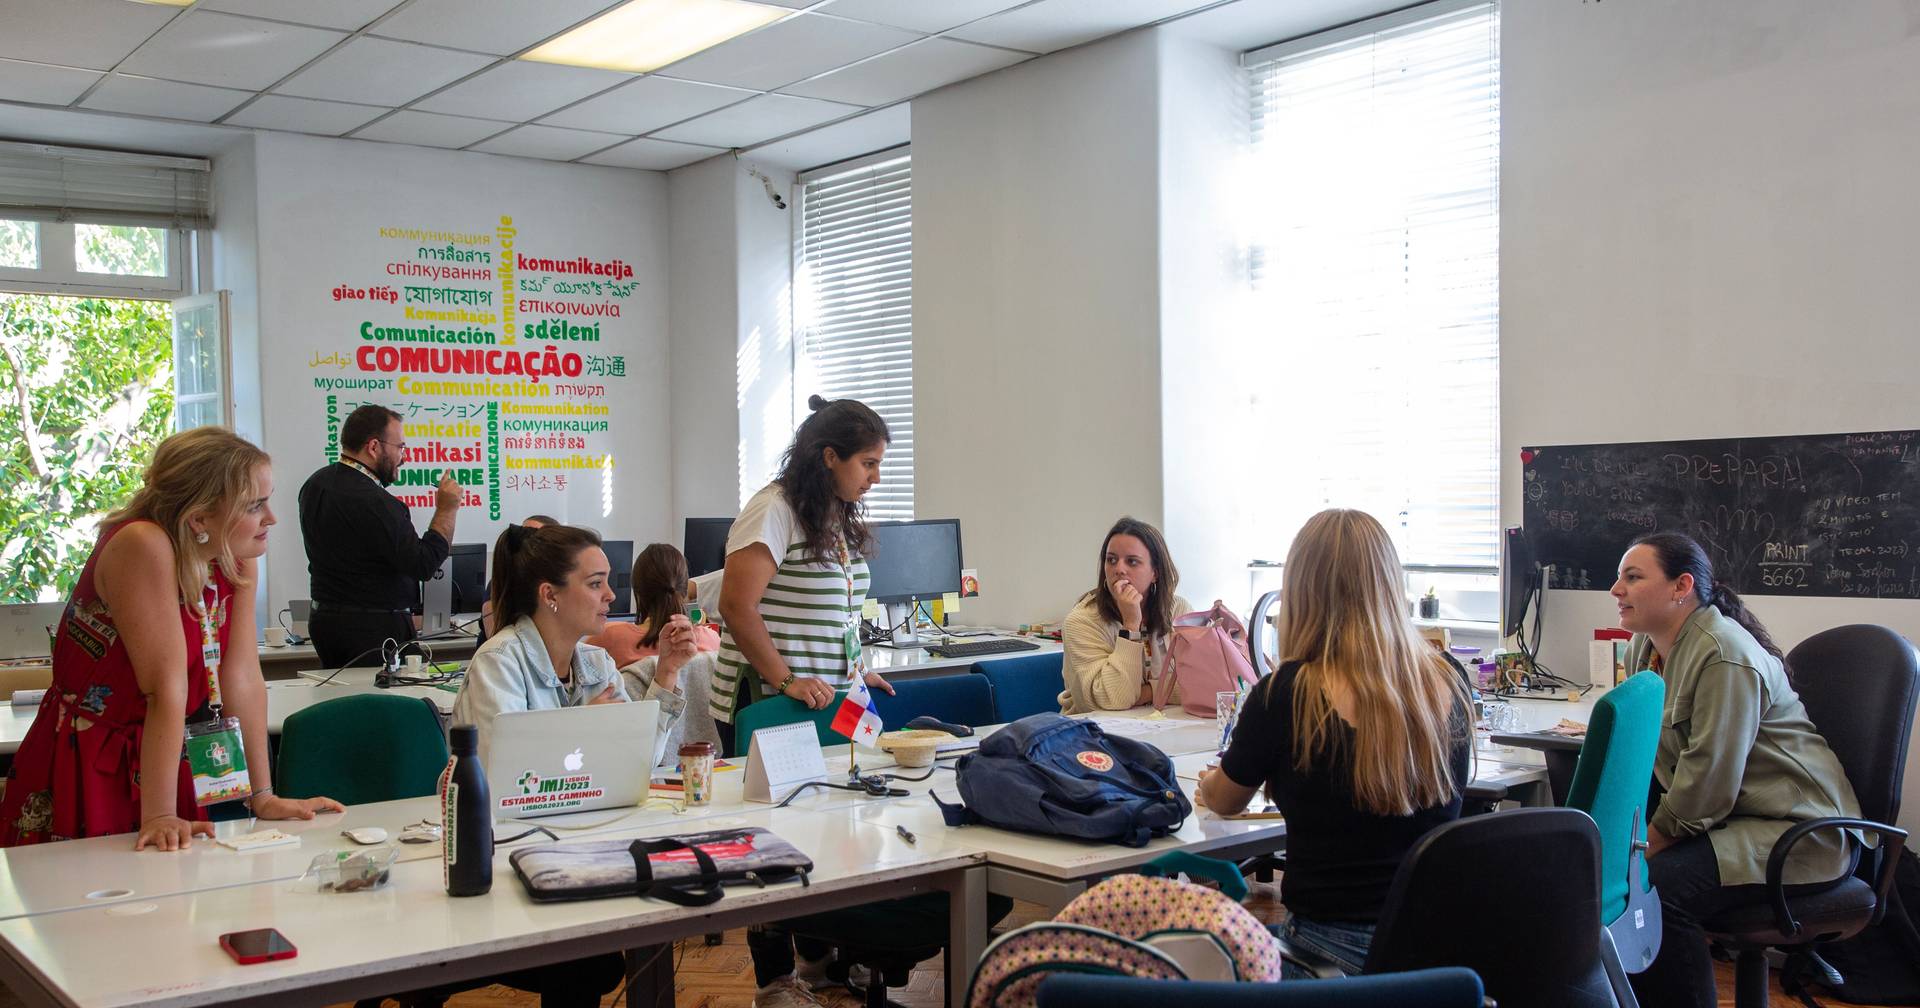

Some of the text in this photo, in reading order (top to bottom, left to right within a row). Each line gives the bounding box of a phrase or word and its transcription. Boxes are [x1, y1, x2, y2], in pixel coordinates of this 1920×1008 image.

[380, 226, 490, 246] коммуникация
[418, 242, 490, 264] การสื่อสาร
[387, 260, 491, 281] спілкування
[518, 253, 633, 280] komunikacija
[497, 215, 517, 346] komunikacije
[332, 284, 398, 304] giao tiếp
[404, 284, 493, 307] যোগাযোগ
[405, 306, 497, 325] Komunikacja
[519, 299, 621, 318] επικοινωνία
[360, 321, 496, 345] Comunicación
[524, 318, 600, 342] sdělení
[309, 351, 352, 369] تواصل
[356, 346, 583, 384] COMUNICAÇÃO
[586, 355, 627, 378] 沟通
[314, 378, 393, 393] муошират
[397, 376, 550, 397] Communication
[344, 400, 487, 419] コニケーション
[502, 400, 609, 415] Kommunikation
[504, 419, 608, 433] комуникация
[486, 401, 498, 521] COMUNICAZIONE
[506, 454, 615, 470] kommunikáci
[506, 475, 568, 491] 의사소통
[1763, 542, 1809, 561] PRINT
[1763, 567, 1808, 588] 5662
[538, 778, 564, 793] JMJ
[564, 782, 589, 791] 2023
[502, 789, 602, 806] ESTAMOS A CAMINHO
[522, 800, 581, 812] LISBOA2023.ORG
[447, 786, 456, 862] LISBOA2023.ORG
